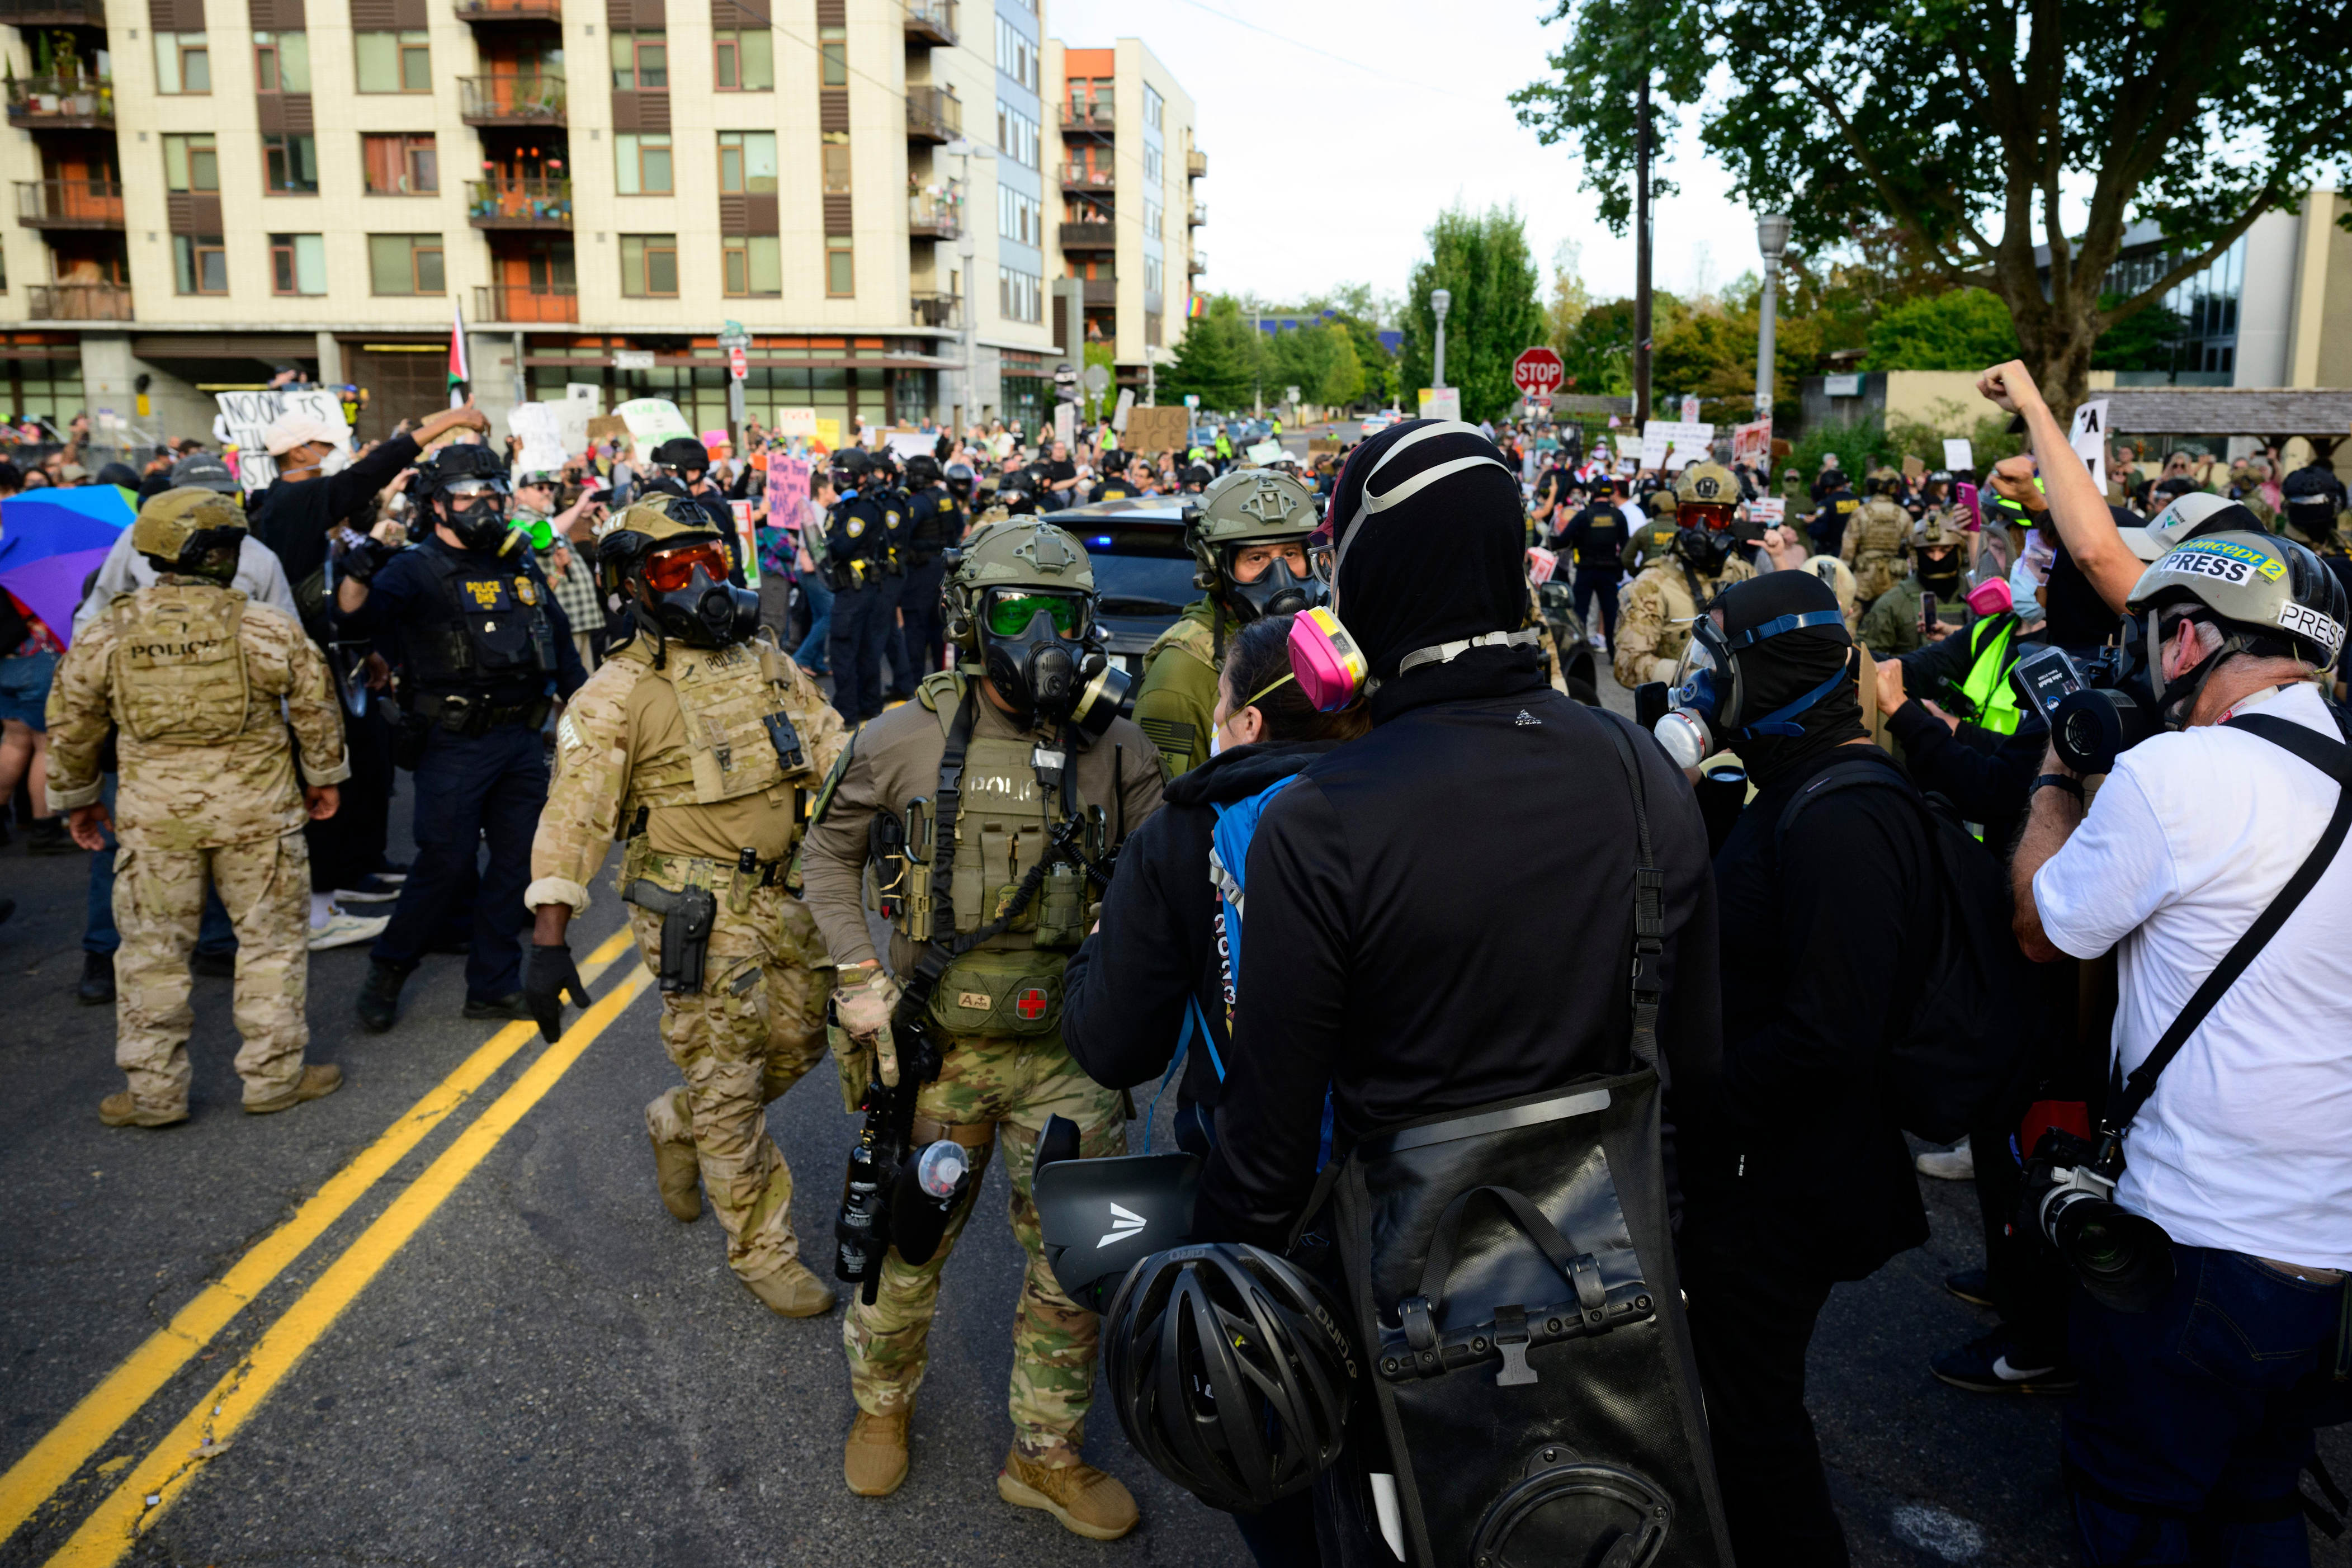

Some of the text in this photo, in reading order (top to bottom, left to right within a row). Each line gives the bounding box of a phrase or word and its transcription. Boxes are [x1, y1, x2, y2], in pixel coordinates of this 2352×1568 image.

[1517, 362, 1560, 382] STOP
[1131, 410, 1184, 429] FUCK
[1131, 430, 1182, 447] ICE
[2162, 553, 2247, 582] PRESS
[2280, 604, 2344, 651] PRESS
[559, 714, 580, 750] SRT
[970, 776, 1047, 803] POLIC
[961, 995, 972, 1005] A
[1315, 1305, 1349, 1359] GIRO
